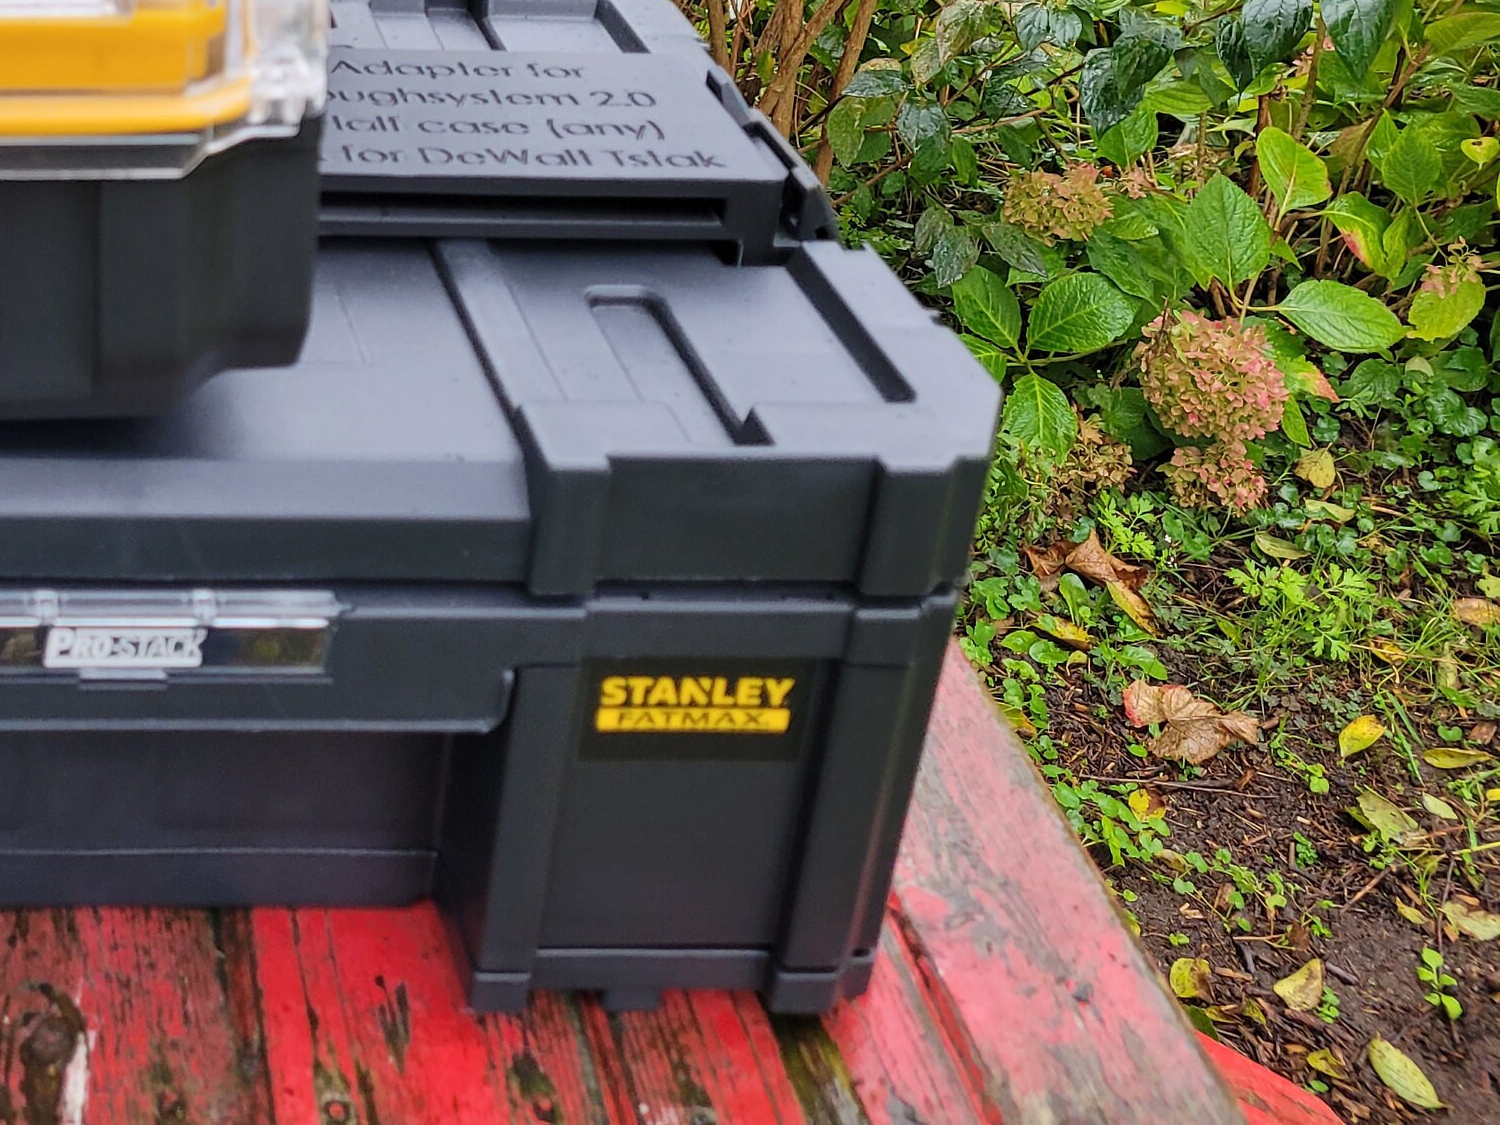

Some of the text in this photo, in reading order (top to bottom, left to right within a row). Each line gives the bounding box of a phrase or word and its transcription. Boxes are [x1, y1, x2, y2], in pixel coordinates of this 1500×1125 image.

[331, 59, 584, 79] Adapter for
[327, 87, 657, 107] ughsystem 2.0
[418, 120, 529, 134] case
[547, 118, 665, 140] (any)
[342, 144, 727, 168] for DeWalt Tstak
[600, 675, 796, 706] STANLEY
[617, 710, 762, 726] FATMAX
